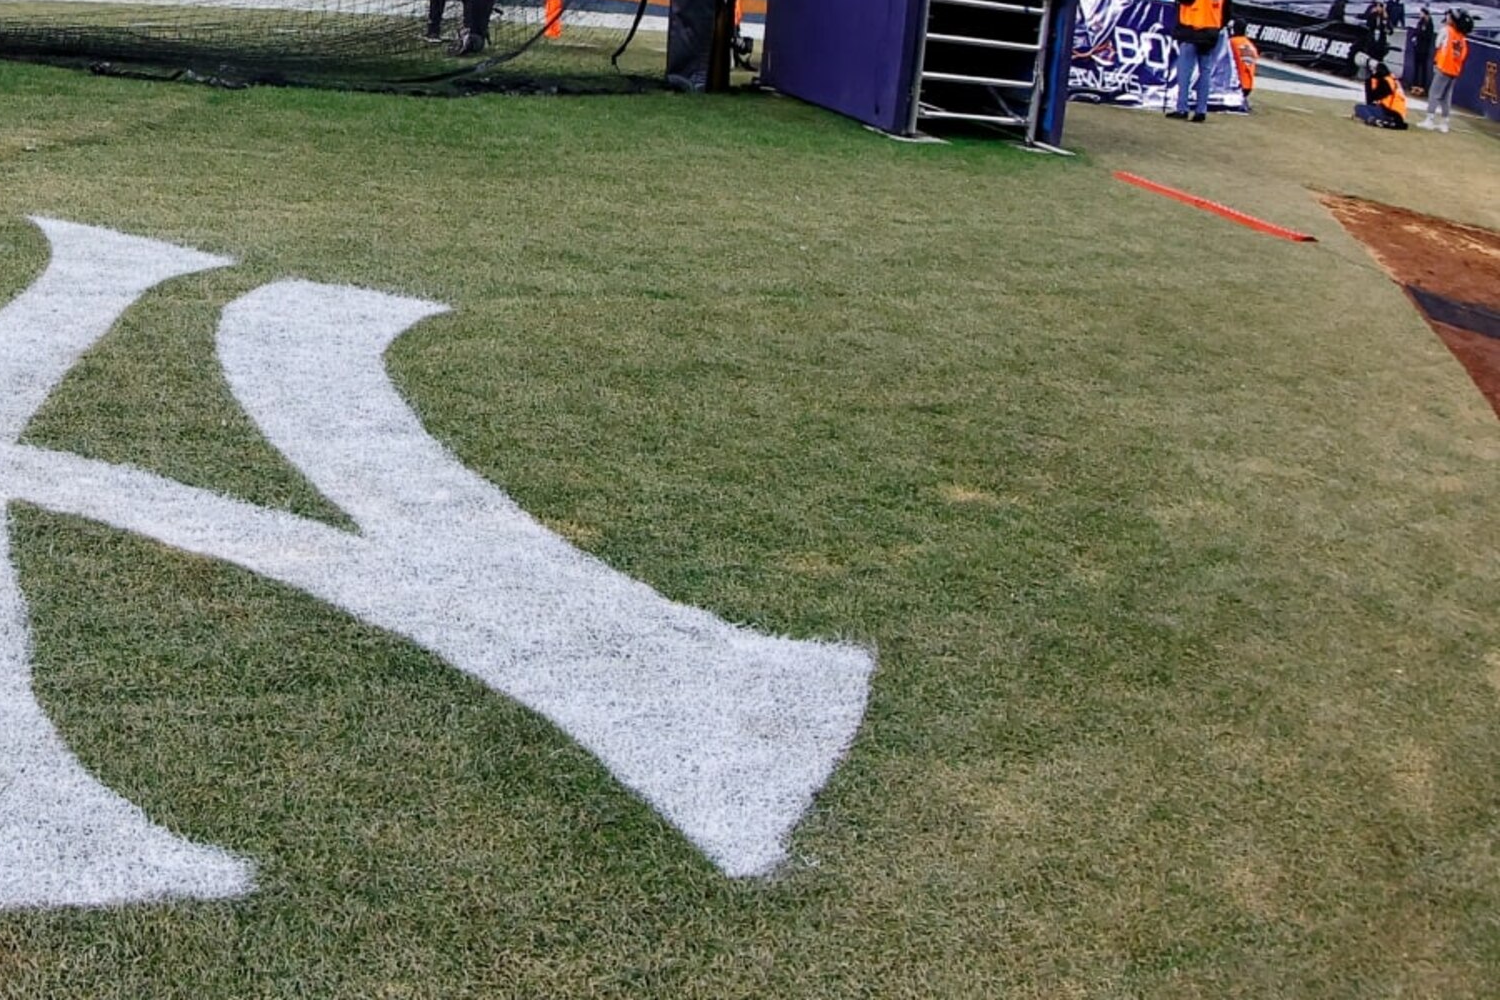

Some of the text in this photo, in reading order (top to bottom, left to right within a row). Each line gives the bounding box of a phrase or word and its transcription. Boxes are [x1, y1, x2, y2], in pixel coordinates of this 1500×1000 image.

[1259, 25, 1300, 48] FOOTBALL
[1301, 34, 1327, 54] LIVES
[1328, 39, 1353, 60] HERE
